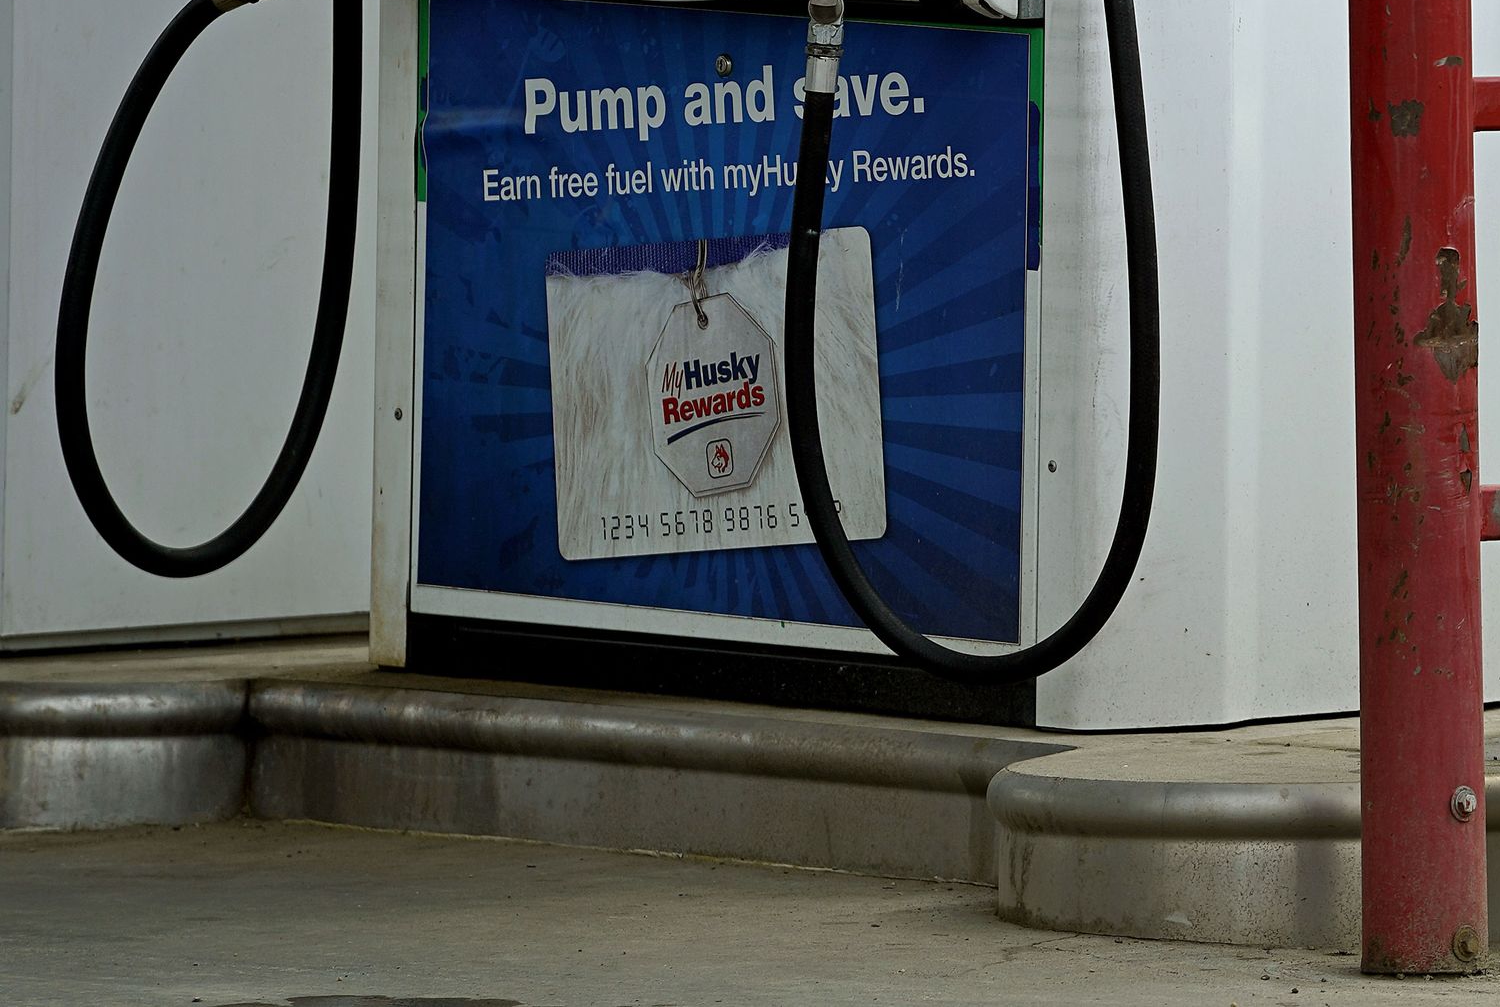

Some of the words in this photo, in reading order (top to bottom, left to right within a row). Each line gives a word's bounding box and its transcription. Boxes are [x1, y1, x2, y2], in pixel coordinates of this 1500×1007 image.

[524, 78, 666, 141] Pump
[684, 65, 775, 125] and
[483, 169, 542, 201] Earn
[549, 164, 598, 199] free
[606, 160, 653, 196] fuel
[662, 159, 716, 192] with
[724, 154, 844, 196] myHuy
[853, 146, 975, 182] Rewards.
[662, 381, 765, 425] Rewards
[601, 515, 649, 540] 1234
[660, 509, 713, 537] 5678
[724, 504, 778, 532] 9876
